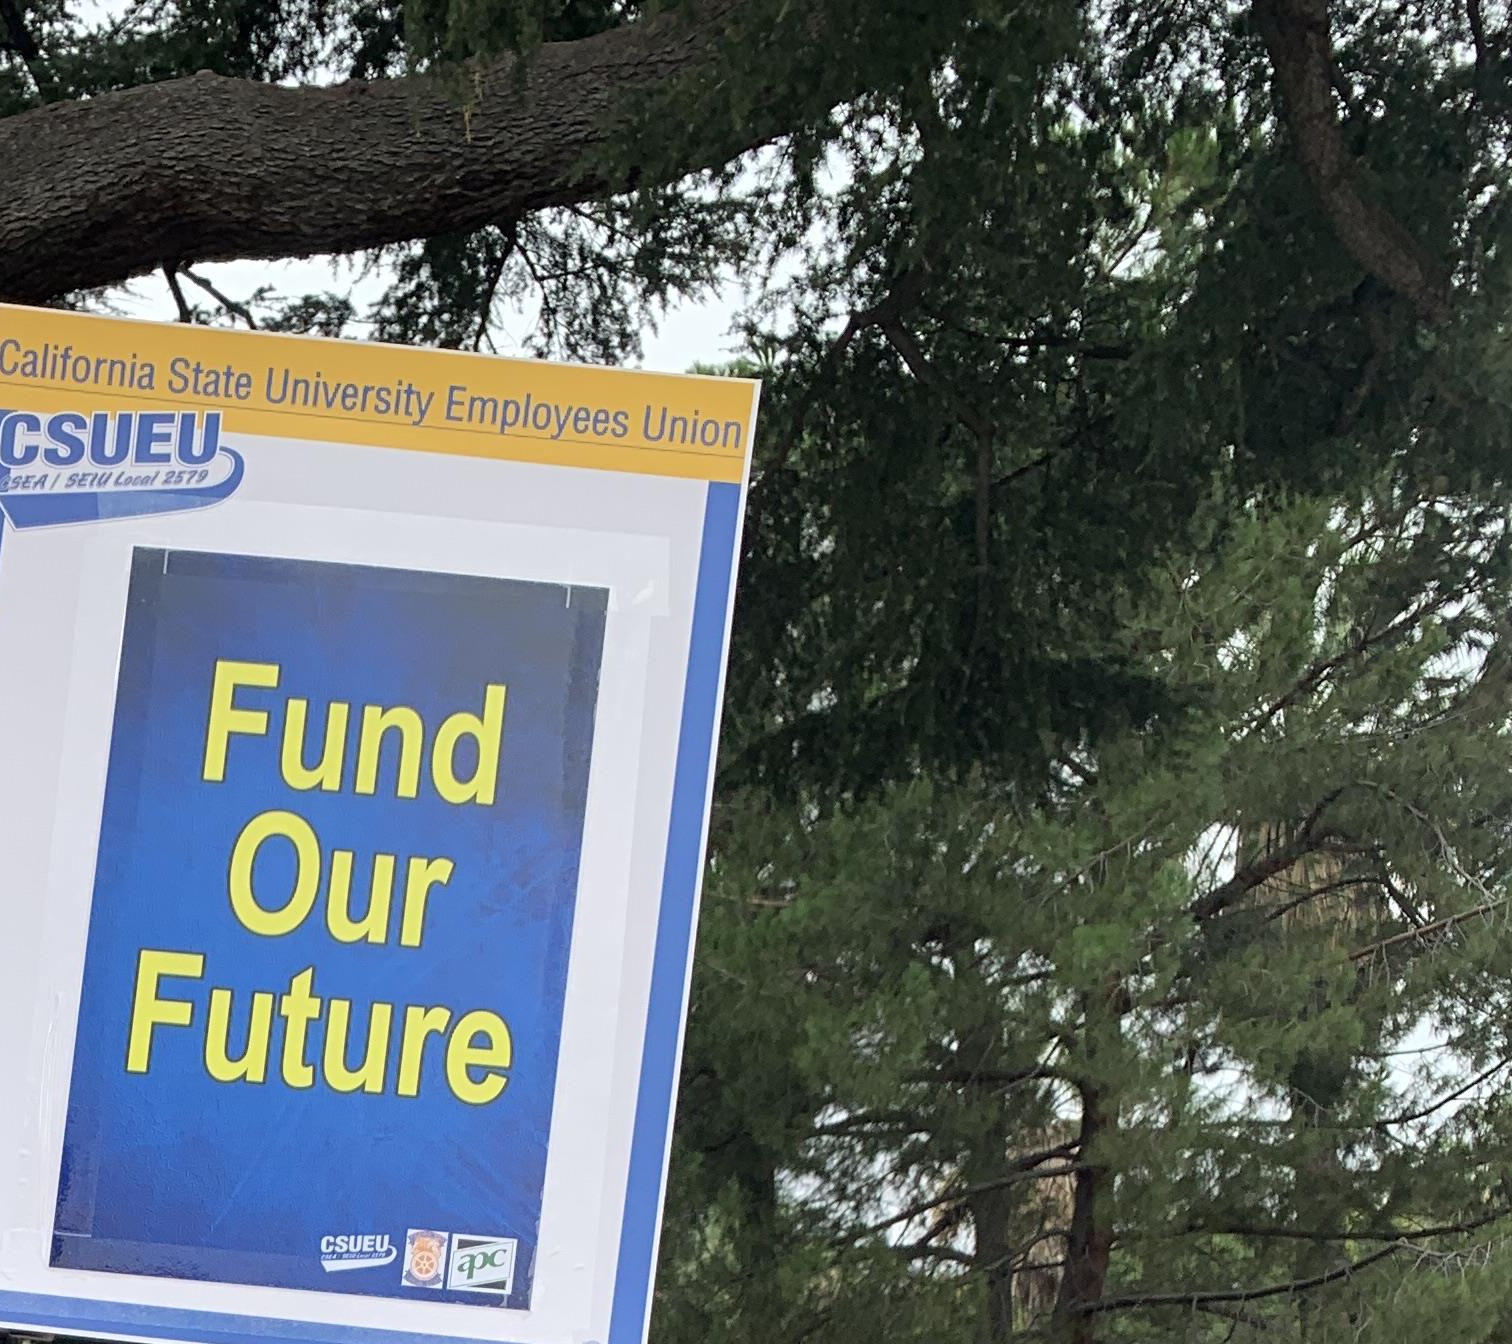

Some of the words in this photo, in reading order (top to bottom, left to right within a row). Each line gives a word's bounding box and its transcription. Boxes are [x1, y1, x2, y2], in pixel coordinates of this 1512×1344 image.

[169, 357, 252, 399] State
[266, 364, 435, 426] University
[446, 384, 629, 439] Employees
[643, 405, 742, 448] Union
[65, 472, 112, 488] SEIU
[114, 470, 160, 486] Local
[162, 469, 209, 485] 2579
[201, 658, 507, 807] Fund
[227, 809, 455, 949] Our
[124, 948, 513, 1105] Future
[320, 1234, 389, 1253] CSUEU
